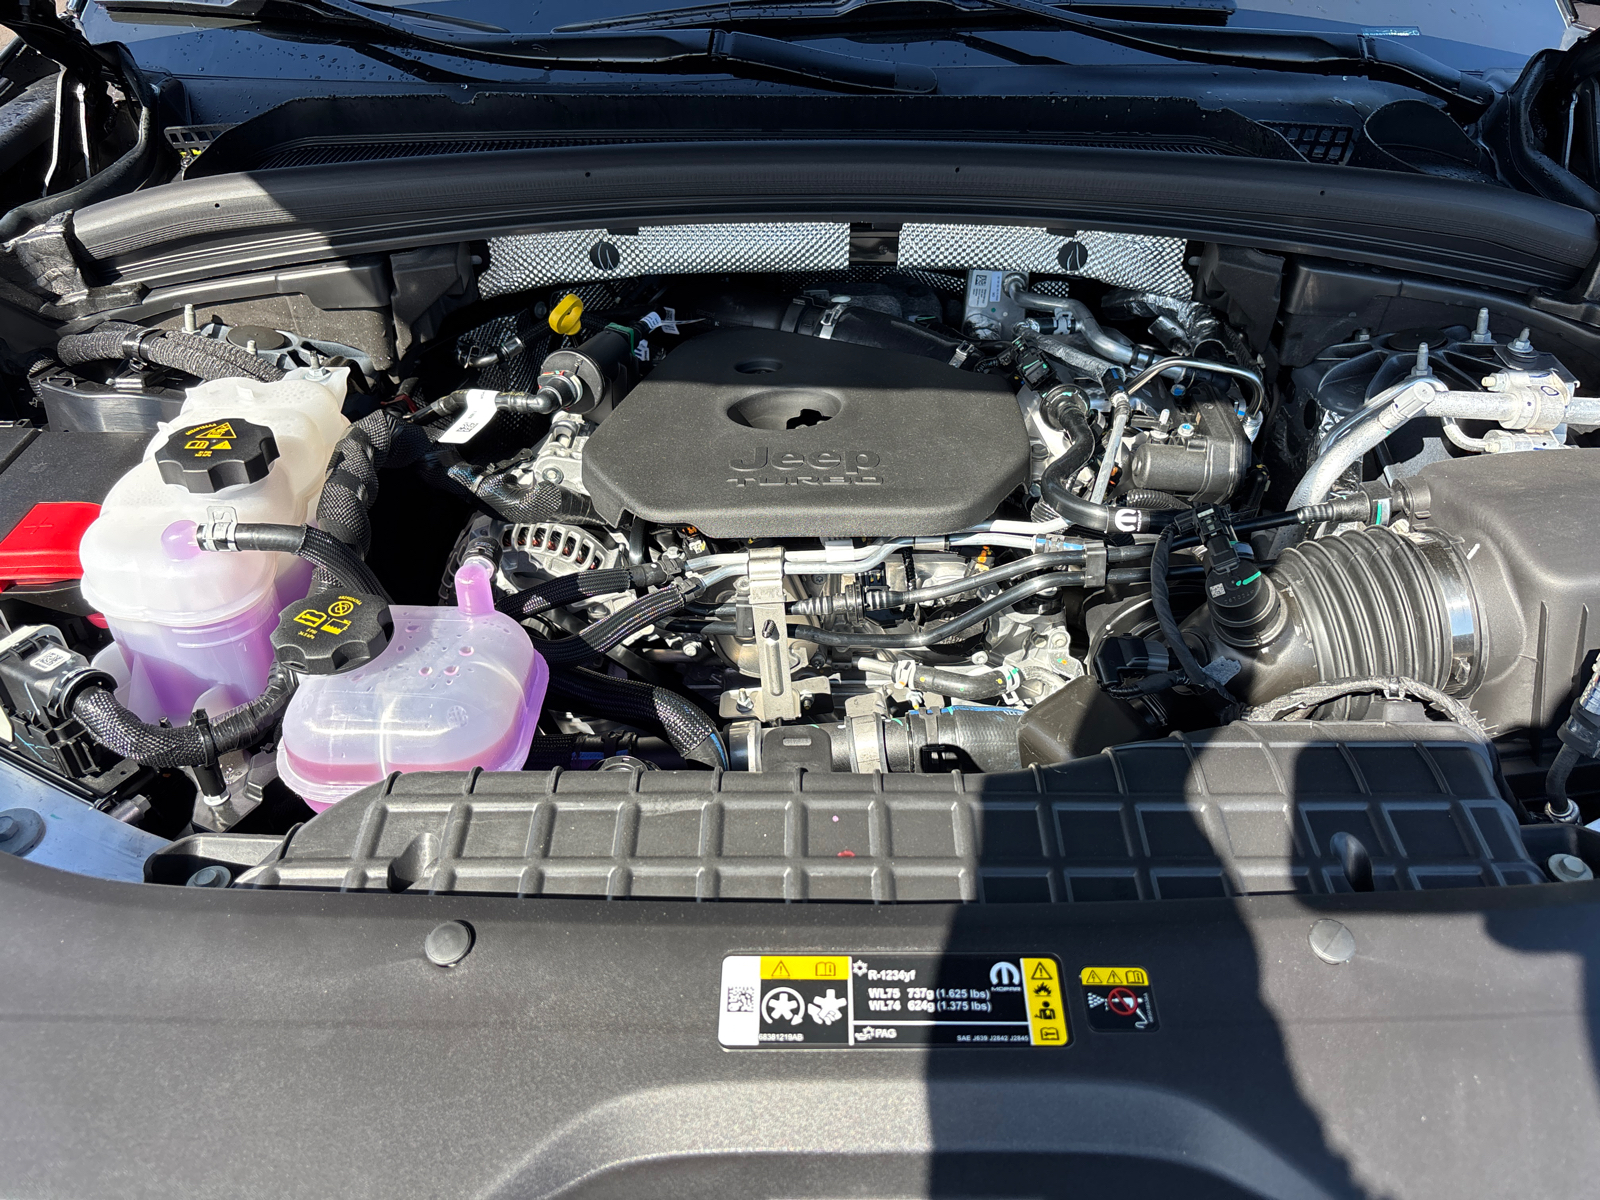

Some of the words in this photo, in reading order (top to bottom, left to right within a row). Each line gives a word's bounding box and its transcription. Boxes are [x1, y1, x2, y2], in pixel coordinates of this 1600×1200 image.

[729, 446, 880, 475] Jeep
[726, 476, 884, 487] TURBO
[868, 969, 916, 982] R-1234yf
[868, 987, 901, 999] WL75
[907, 988, 934, 1000] 737g
[936, 988, 968, 1000] (1.625
[970, 988, 990, 1000] lbs)
[868, 1000, 901, 1011] WL74
[907, 1000, 936, 1013] 624g
[937, 1000, 969, 1012] (1.375
[971, 1001, 991, 1012] lbs)
[875, 1028, 897, 1038] PAG
